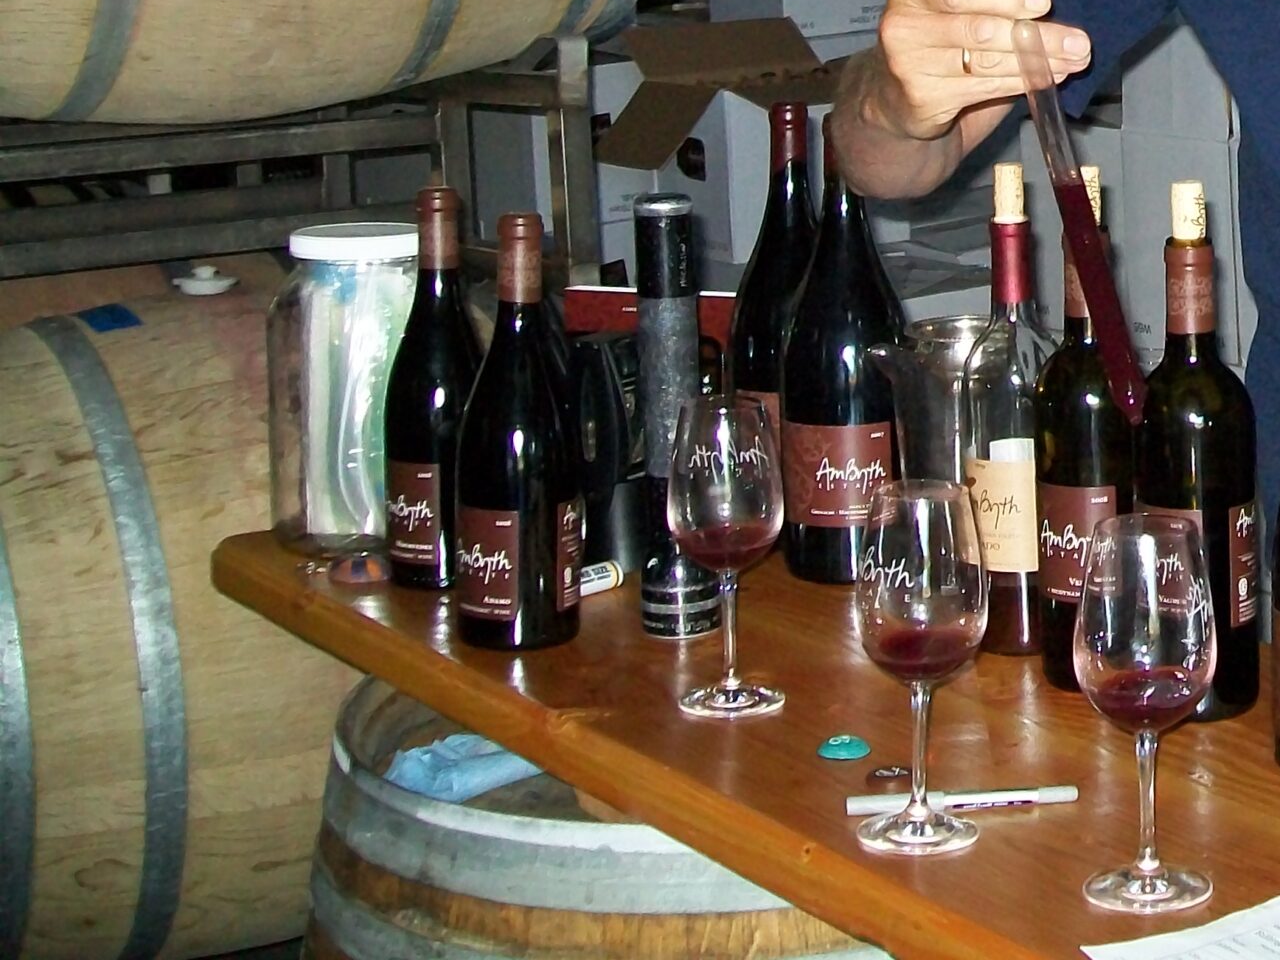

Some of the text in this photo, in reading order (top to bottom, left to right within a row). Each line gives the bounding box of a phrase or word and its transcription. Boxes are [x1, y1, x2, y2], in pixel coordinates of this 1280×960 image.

[816, 457, 886, 494] AmByth
[387, 494, 434, 532] mByth
[973, 489, 1021, 530] Byth
[861, 546, 915, 608] Byth
